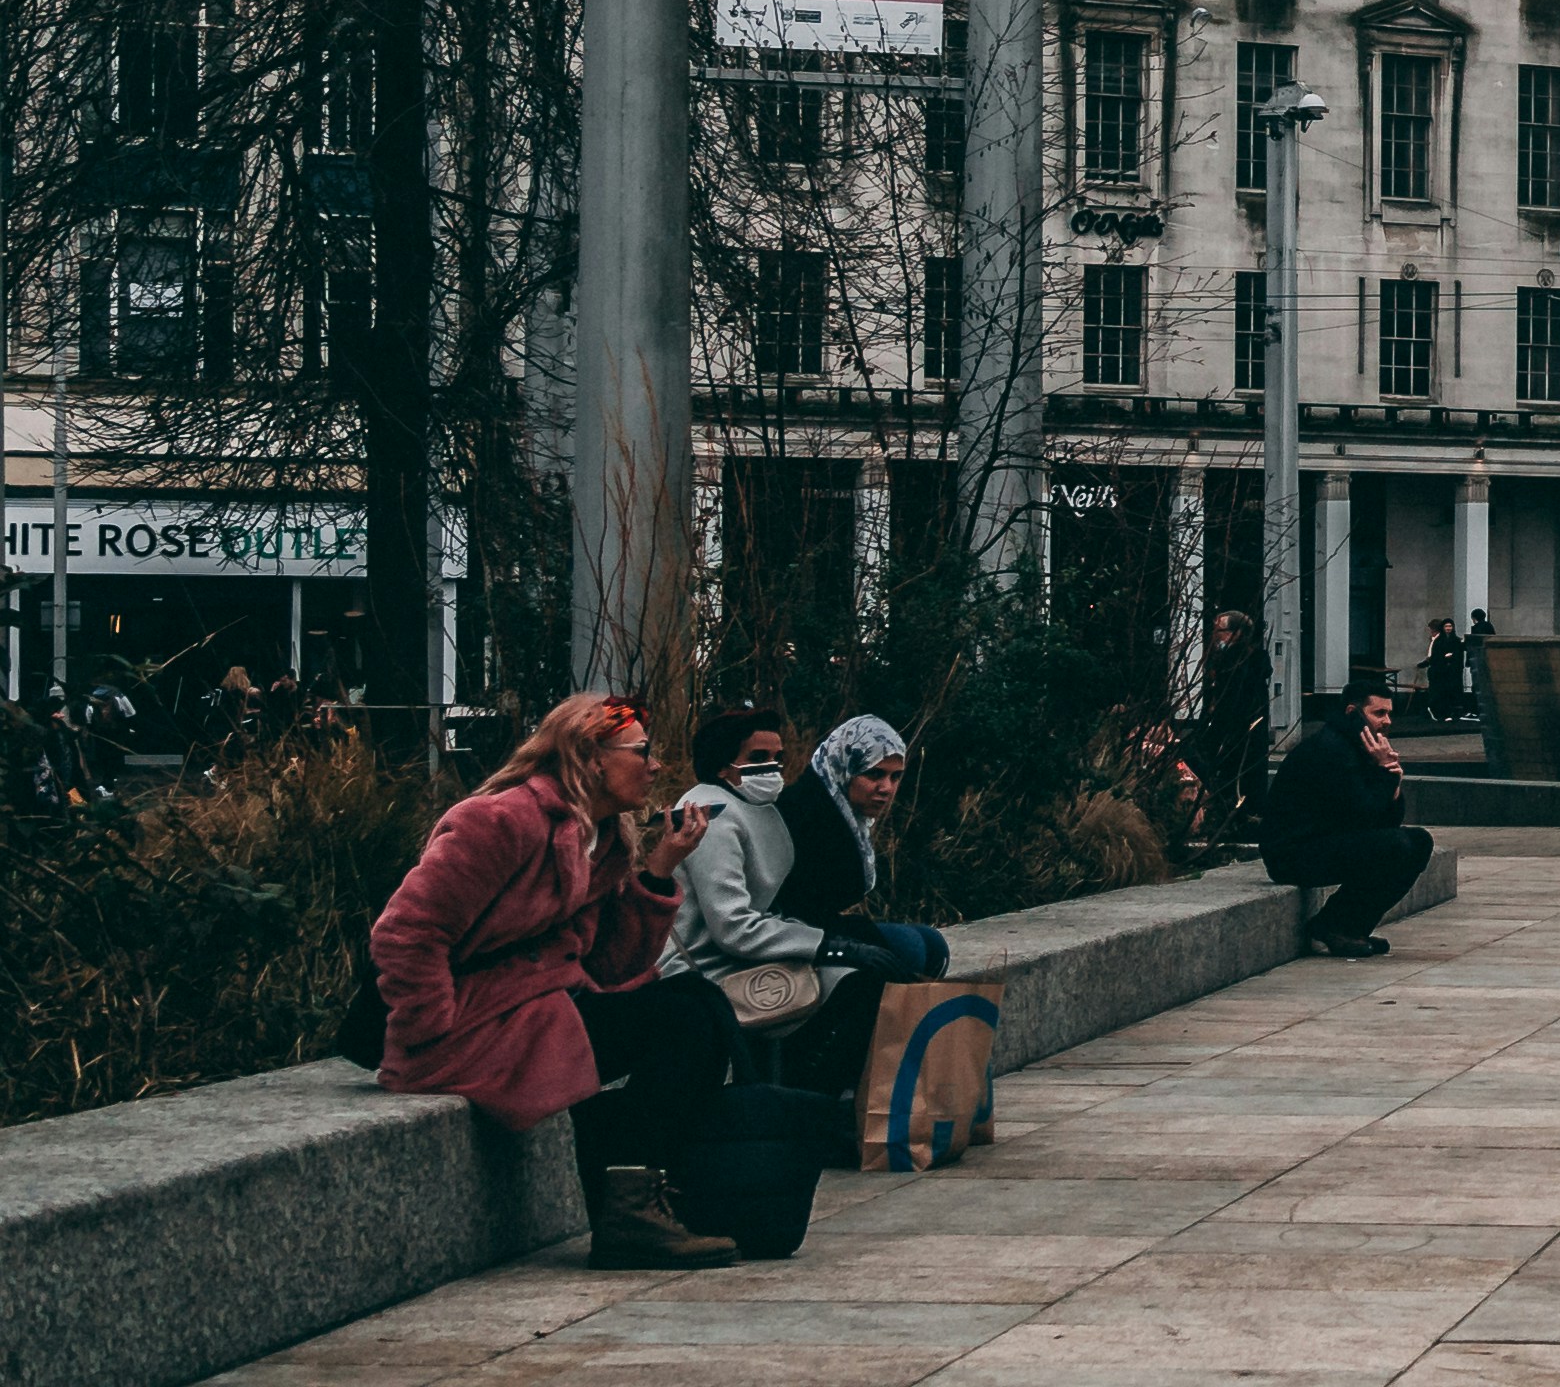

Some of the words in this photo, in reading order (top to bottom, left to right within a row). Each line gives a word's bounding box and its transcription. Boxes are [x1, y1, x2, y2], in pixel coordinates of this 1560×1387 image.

[1050, 484, 1119, 517] Neill's
[97, 523, 209, 558] ROSE
[220, 524, 368, 560] OUTLE
